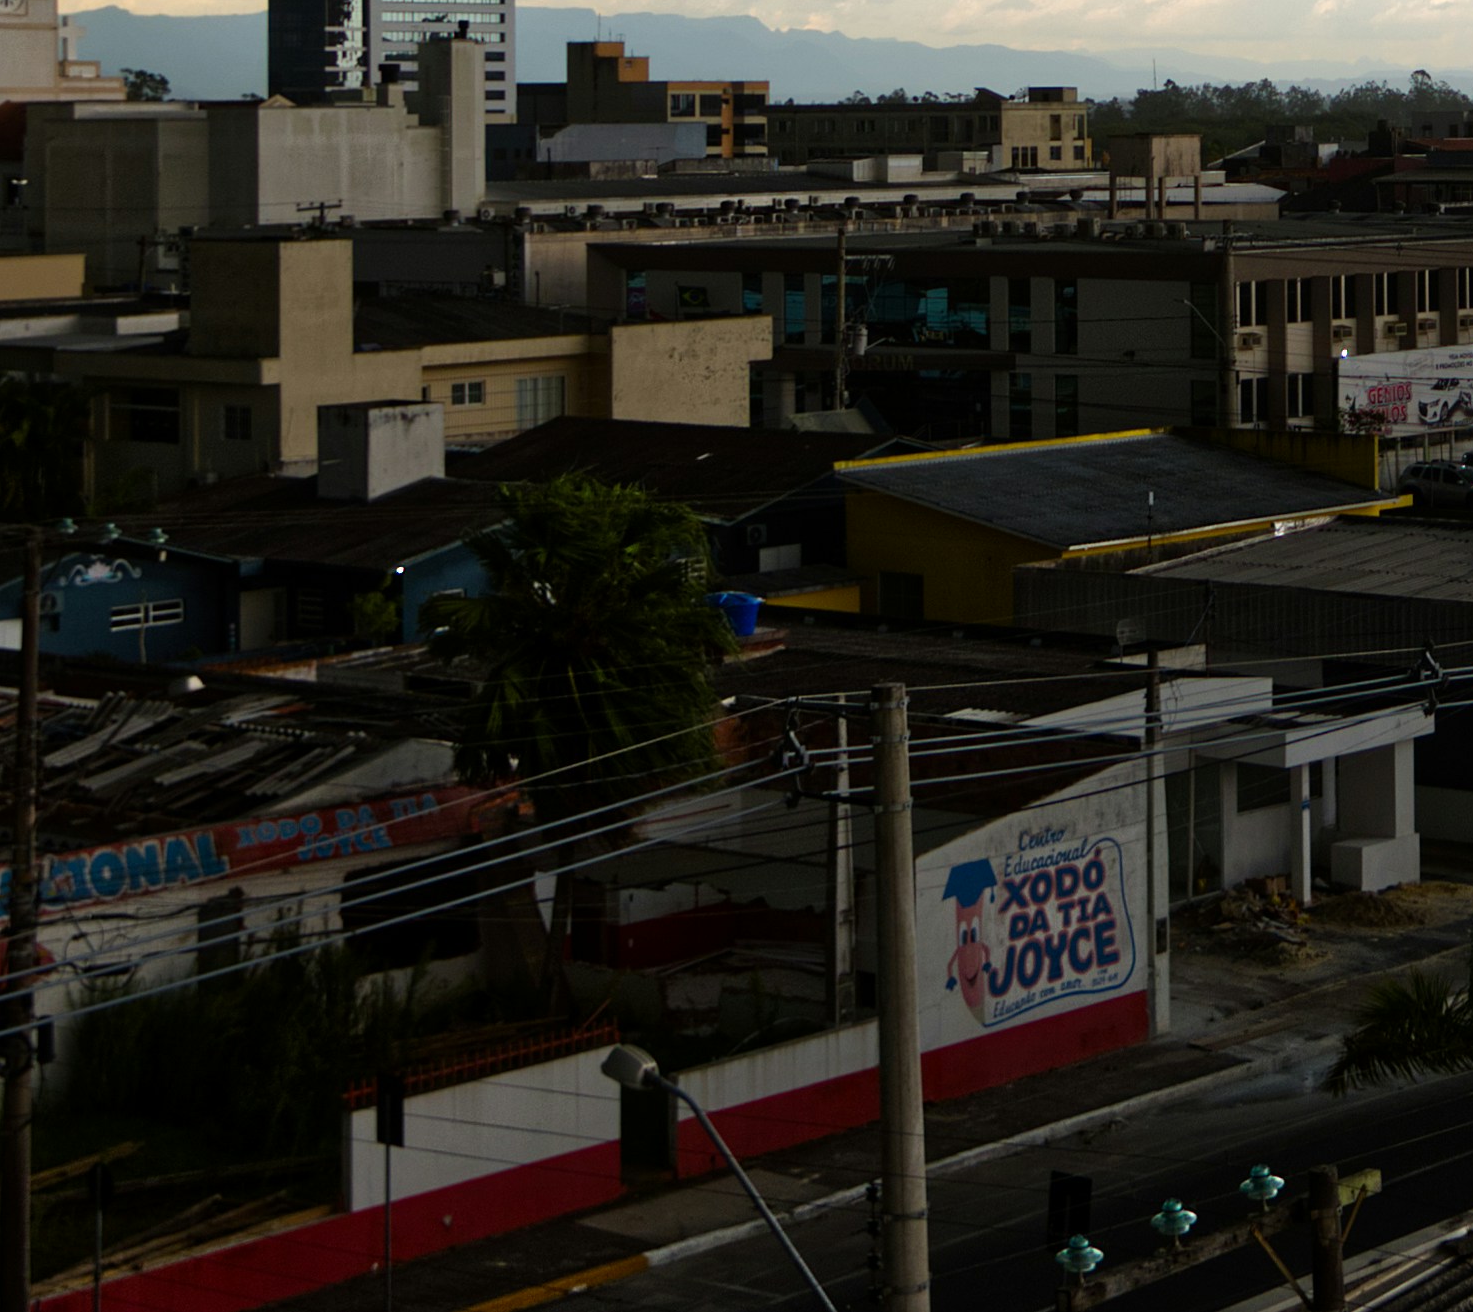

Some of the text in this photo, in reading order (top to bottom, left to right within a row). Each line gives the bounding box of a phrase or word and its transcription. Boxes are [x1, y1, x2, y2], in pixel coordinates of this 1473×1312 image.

[846, 355, 914, 371] ORUM
[237, 793, 440, 848] XODO DA TIA
[1018, 827, 1066, 852] Centro
[296, 826, 393, 861] JOYCE
[1004, 838, 1088, 877] Educacional
[998, 846, 1106, 913] XODÓ
[1009, 892, 1113, 941] DA TIA
[988, 917, 1120, 997] JOYCE
